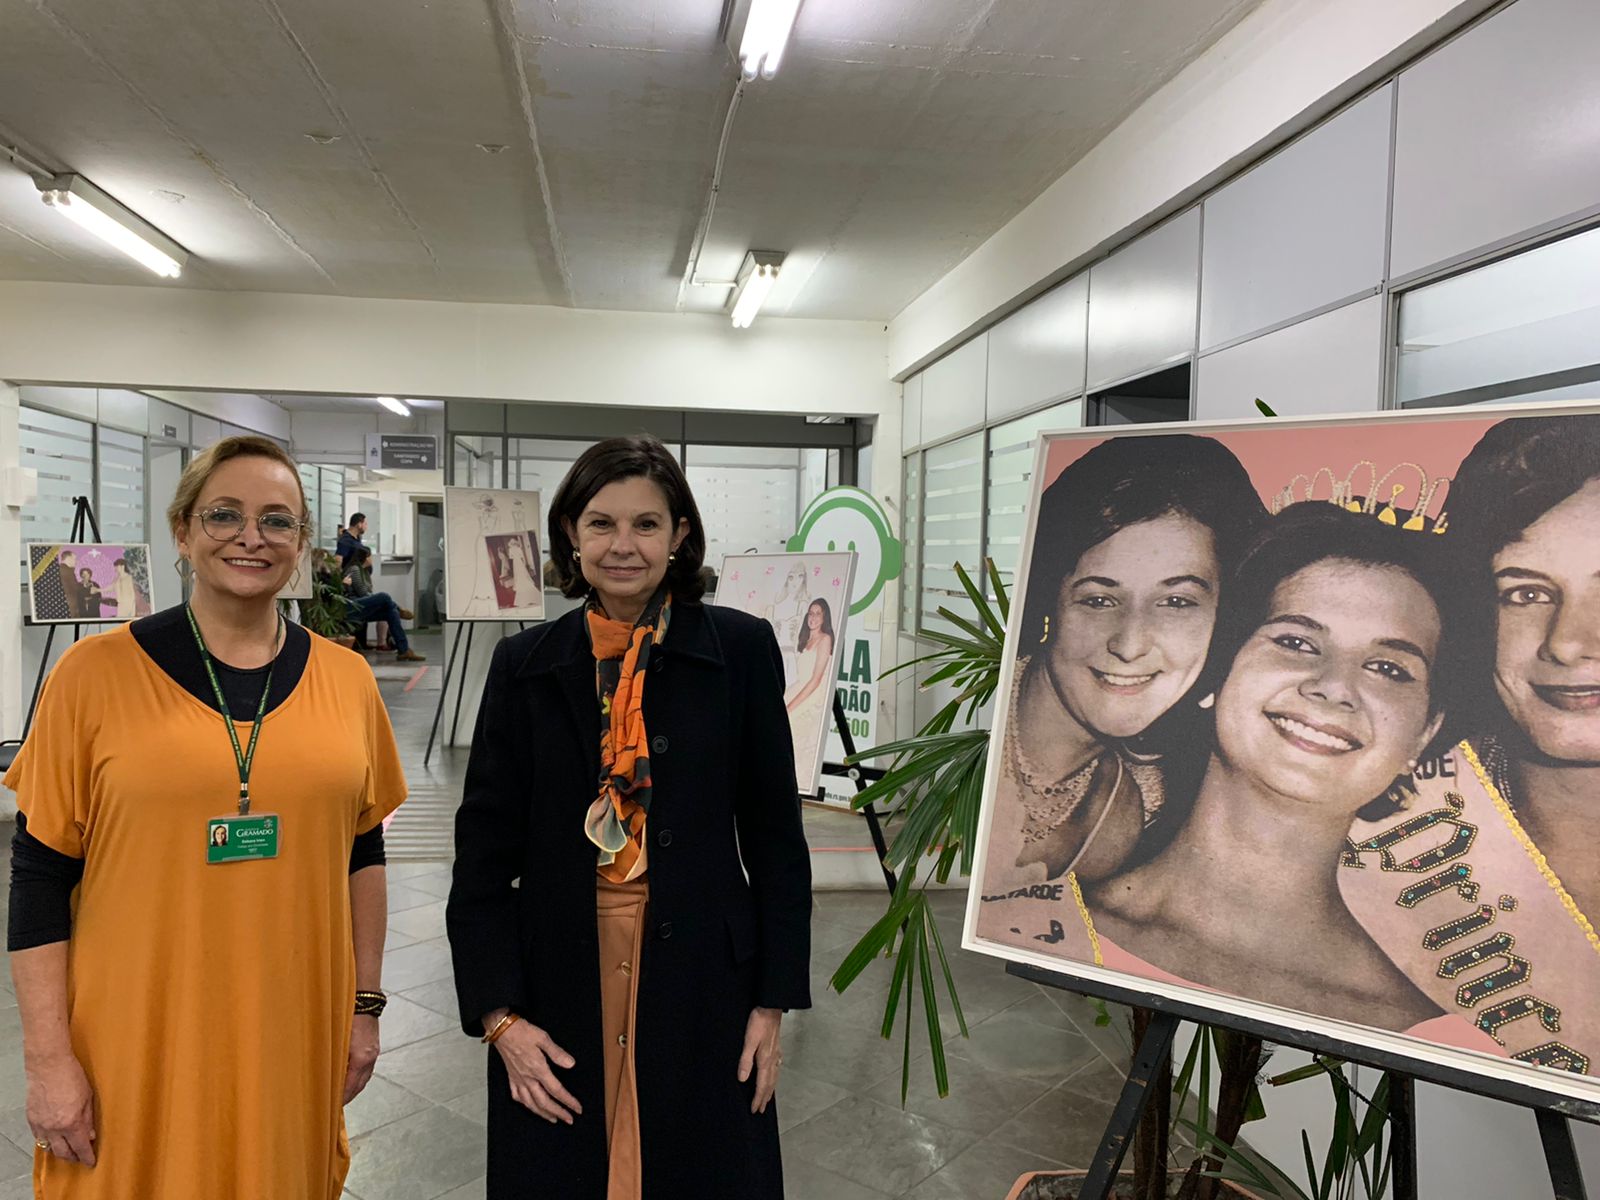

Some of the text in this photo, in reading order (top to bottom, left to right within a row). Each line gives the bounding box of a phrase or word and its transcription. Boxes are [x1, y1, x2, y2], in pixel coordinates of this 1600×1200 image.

[837, 639, 872, 684] LA
[839, 685, 871, 713] DÃO
[236, 828, 274, 838] GRAMADO
